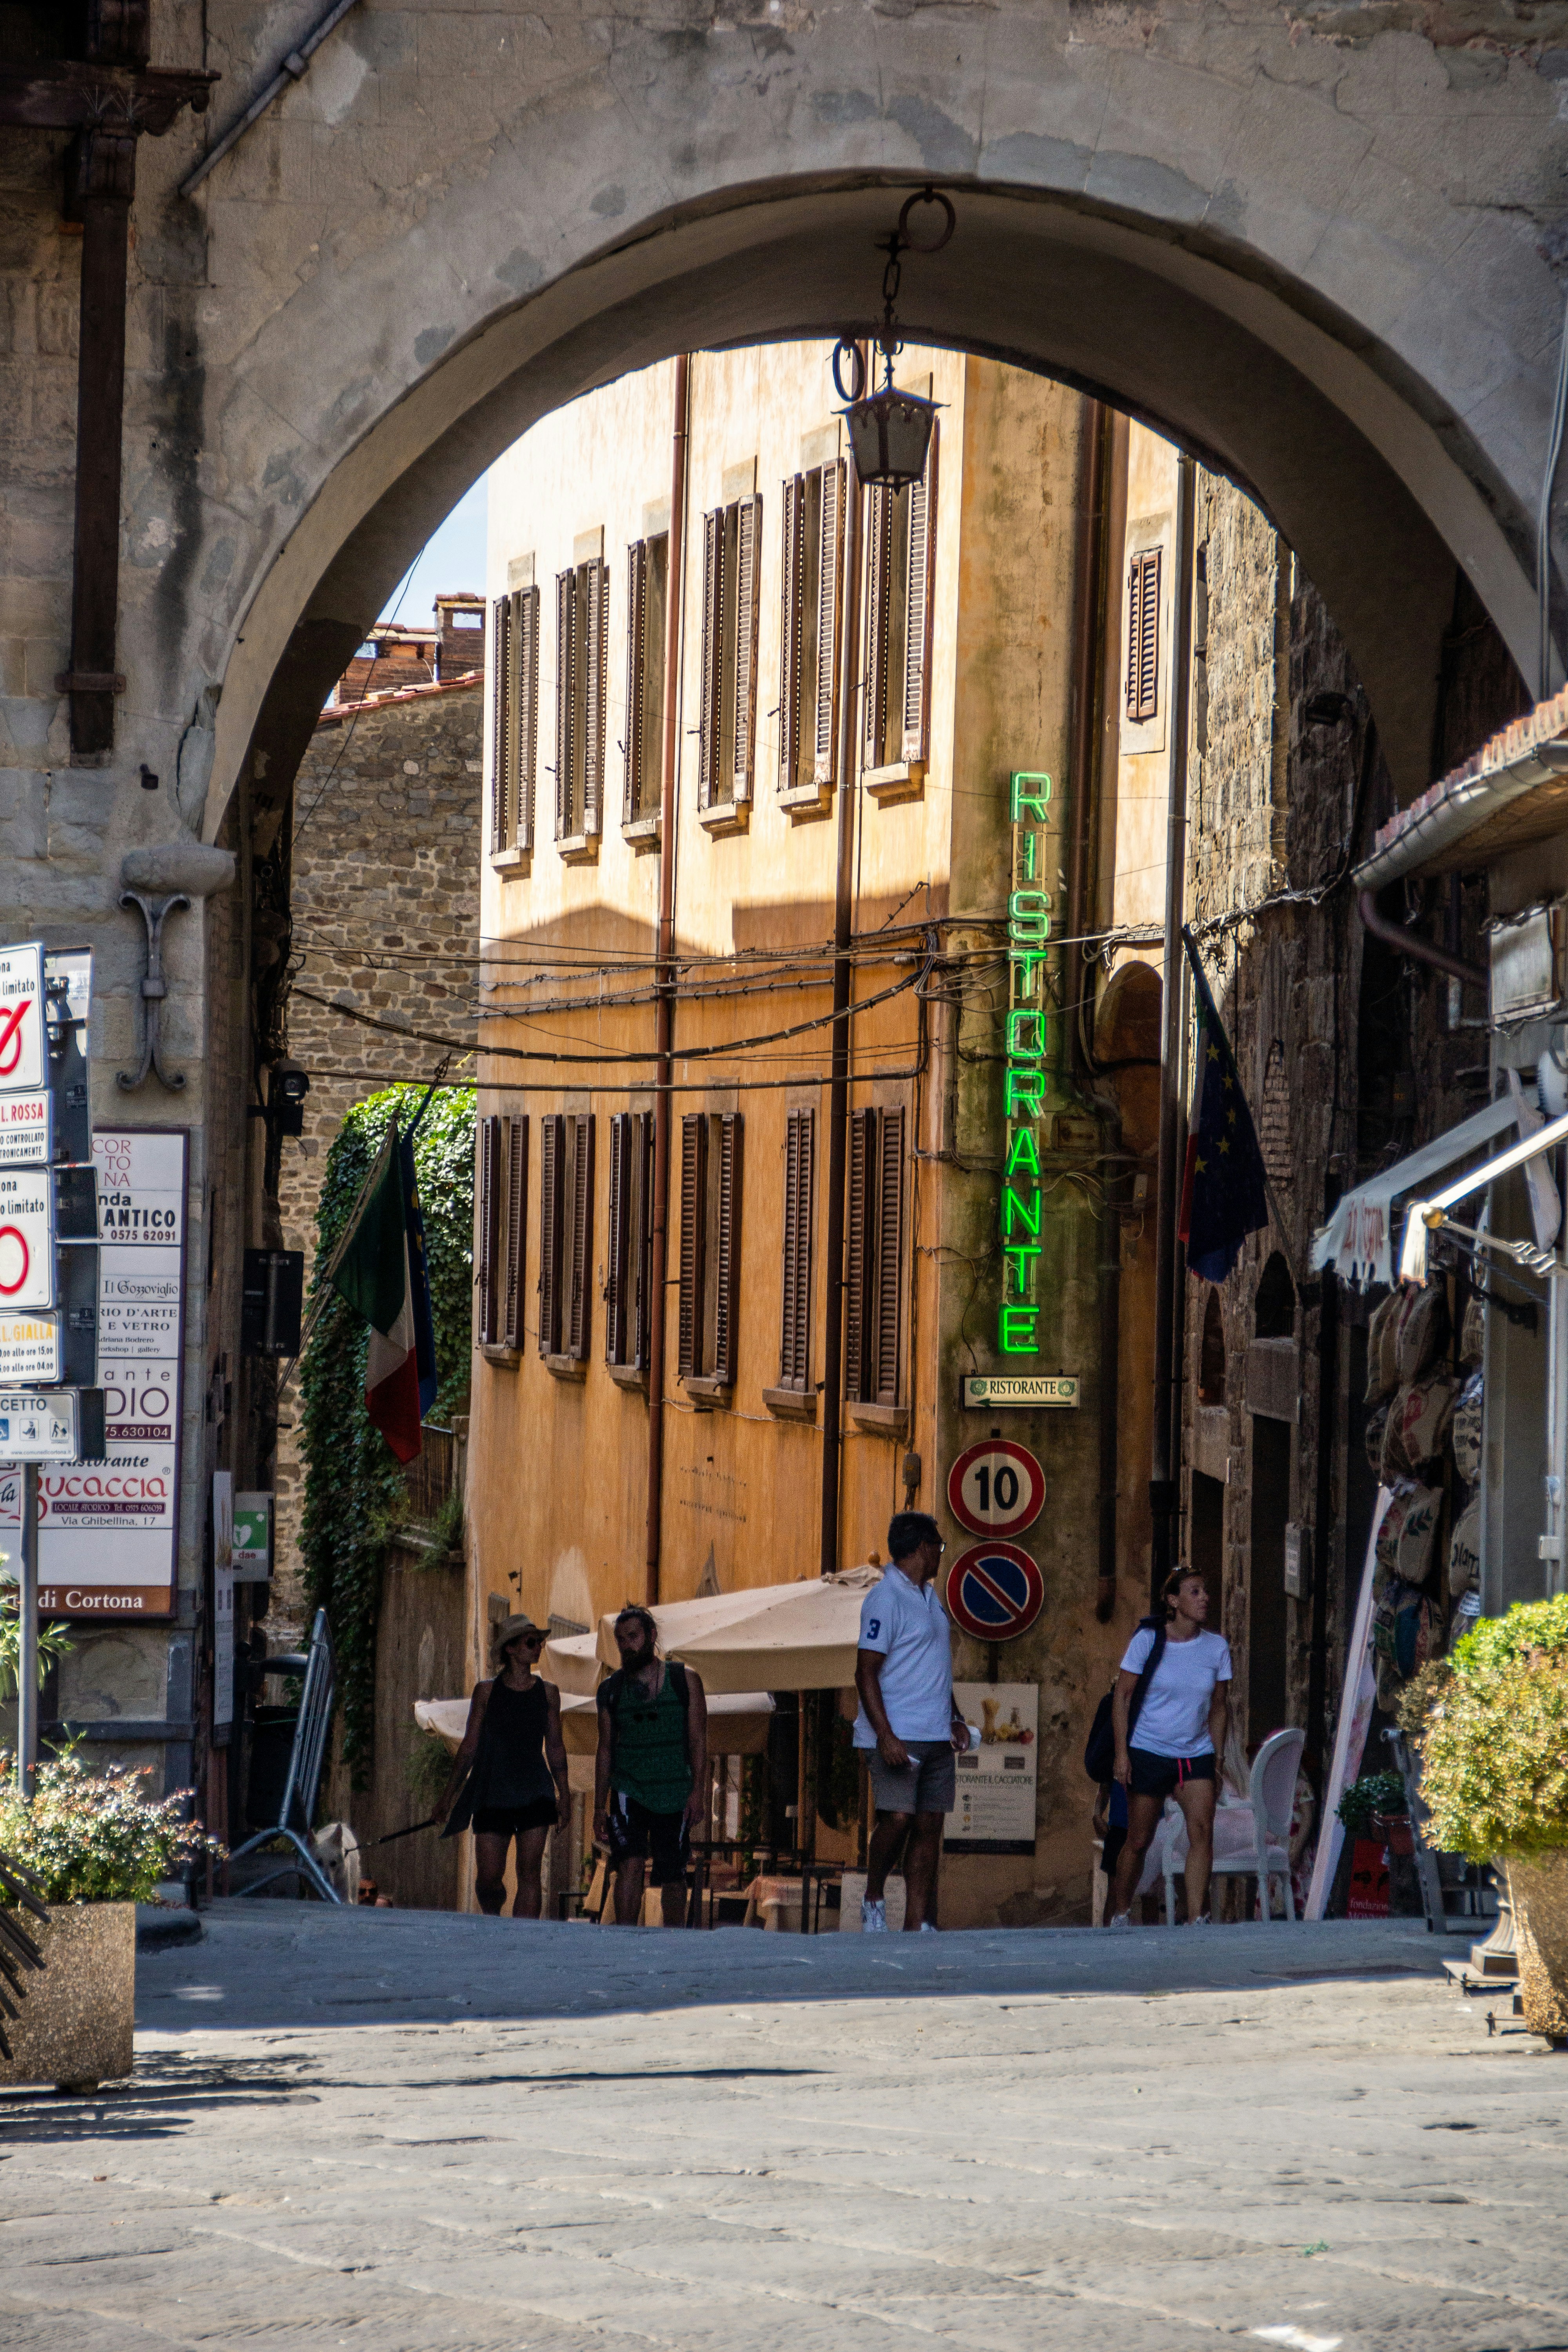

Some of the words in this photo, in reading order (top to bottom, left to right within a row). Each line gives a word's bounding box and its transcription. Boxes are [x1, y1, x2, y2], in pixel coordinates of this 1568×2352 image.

[0, 962, 10, 973] na
[3, 978, 34, 995] limitato
[998, 771, 1054, 1354] RISTORANTE
[11, 1103, 43, 1122] ROSSA
[6, 1132, 44, 1144] CONTROLLATO
[92, 1139, 131, 1154] COR
[105, 1156, 130, 1170] TO
[1, 1181, 16, 1192] ona
[104, 1172, 131, 1187] NA
[8, 1198, 44, 1214] limitato
[98, 1192, 131, 1206] nda
[103, 1209, 175, 1227] ANTICO
[111, 1230, 138, 1240] 0575
[143, 1231, 176, 1241] 62091
[118, 1280, 178, 1298] Gozzoviglio
[127, 1308, 177, 1317] D'ARTE
[13, 1323, 53, 1341] GIALLA
[108, 1322, 116, 1330] E
[122, 1322, 170, 1331] VETRO
[12, 1348, 24, 1356] alle
[12, 1363, 24, 1372] alle
[104, 1368, 170, 1381] ante
[990, 1381, 1056, 1394] RISTORANTE
[0, 1398, 47, 1411] CETTO
[104, 1387, 169, 1418] DIO
[975, 1466, 1019, 1510] 10
[54, 1503, 78, 1512] LOCALE
[81, 1503, 110, 1512] STORICO
[61, 1516, 78, 1526] Via
[81, 1516, 138, 1526] Ghibellina,
[143, 1517, 156, 1525] 17
[38, 1590, 56, 1608] di
[65, 1591, 143, 1608] Cortona
[867, 1618, 881, 1640] 3
